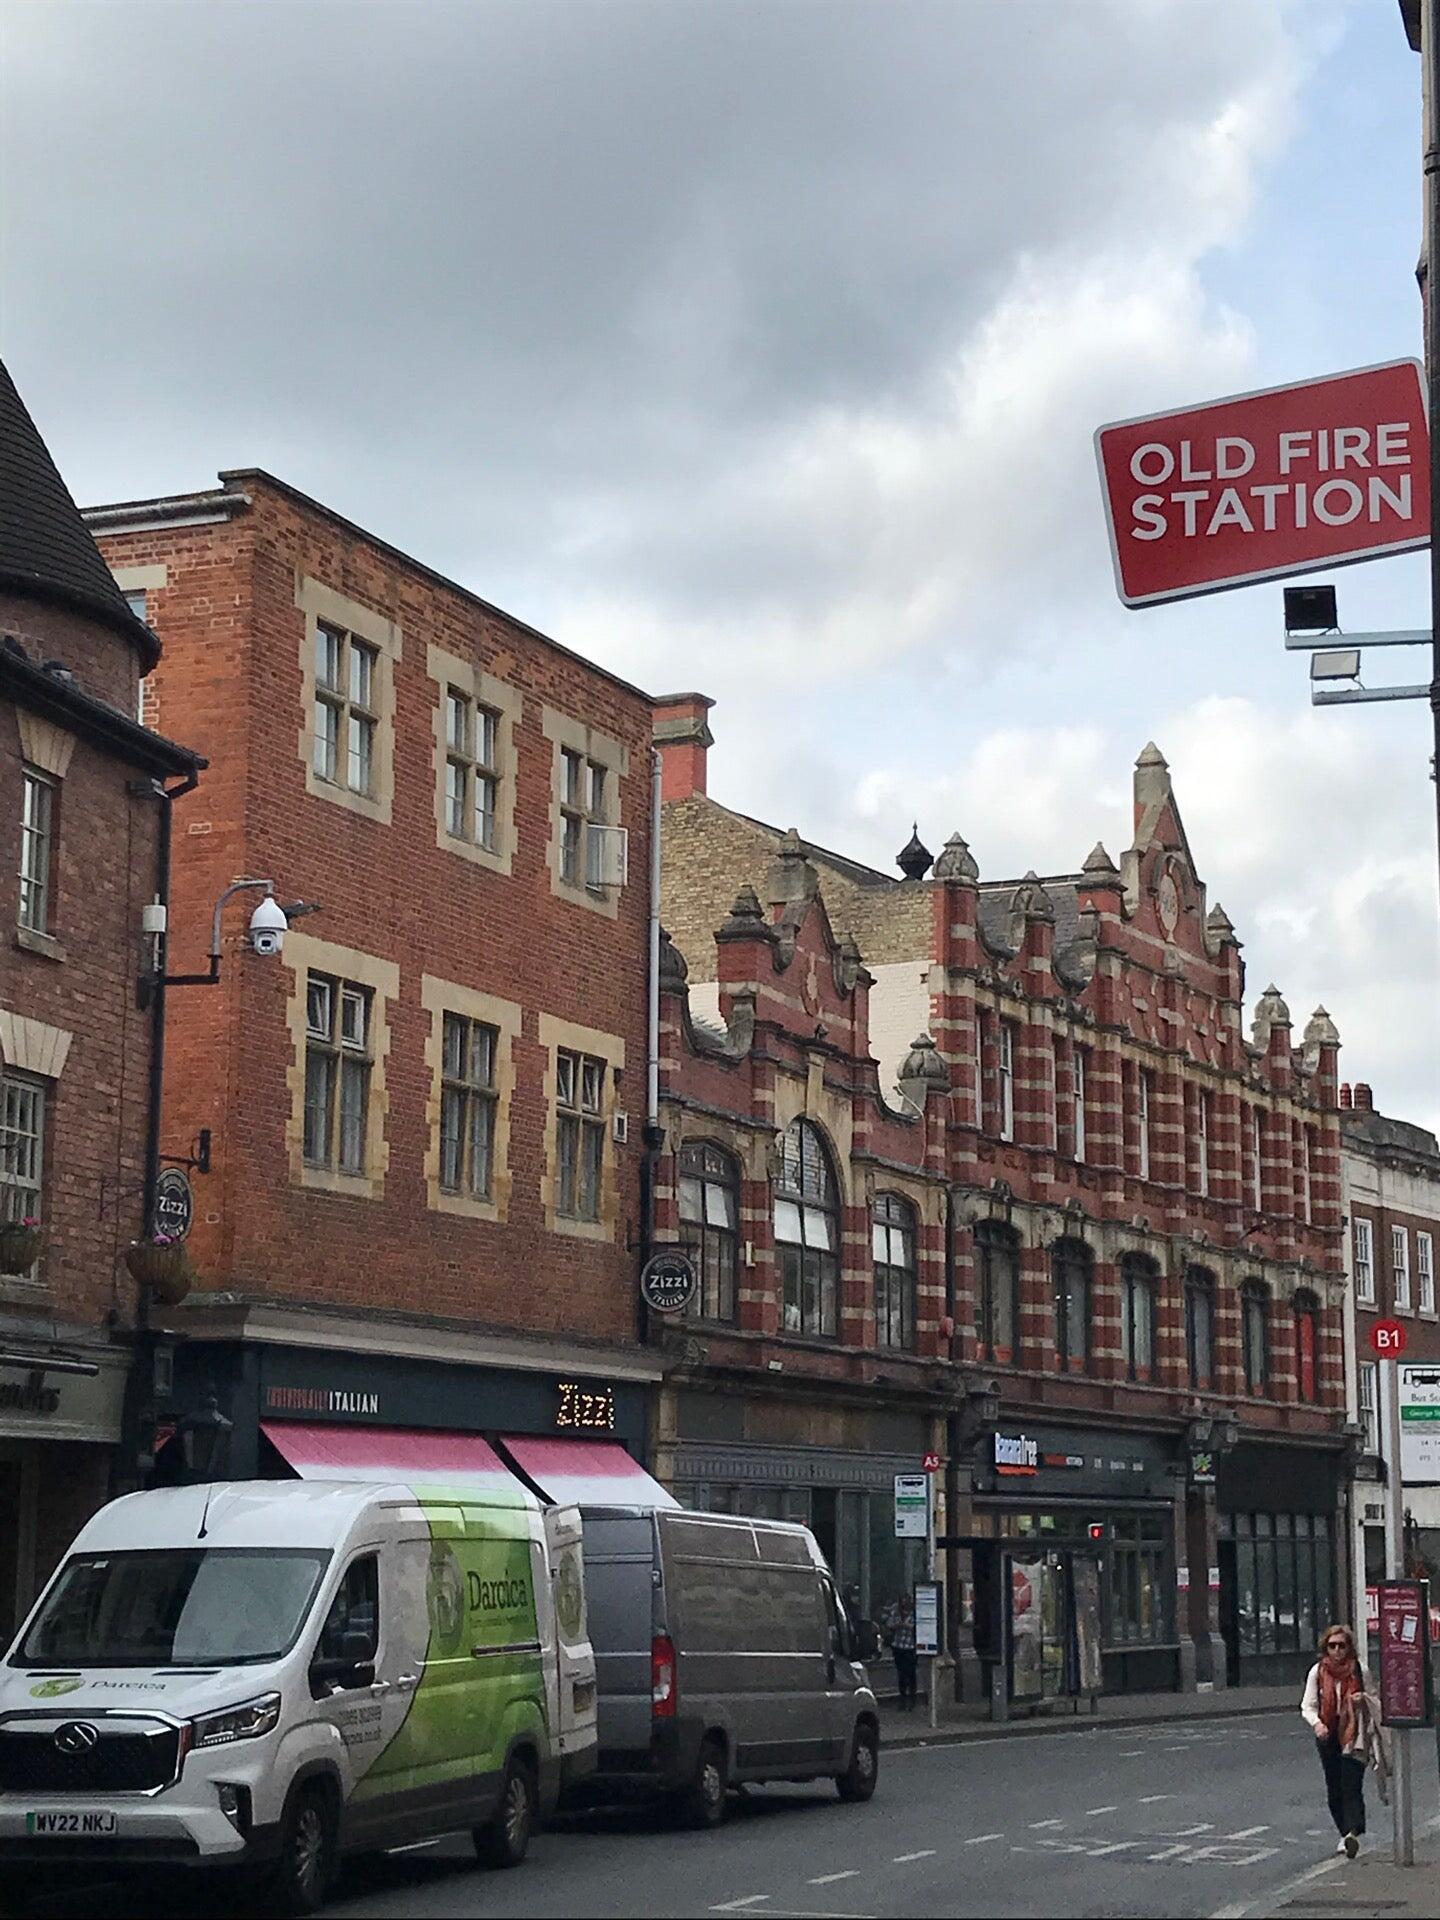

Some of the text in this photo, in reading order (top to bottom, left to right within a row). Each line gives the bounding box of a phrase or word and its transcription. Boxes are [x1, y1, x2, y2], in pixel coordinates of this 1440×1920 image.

[1130, 422, 1411, 486] OLD FIRE
[1131, 474, 1413, 541] STATION
[159, 1195, 188, 1217] Zizzi
[649, 1273, 688, 1289] Zizzi
[1377, 1329, 1400, 1348] B1
[329, 1390, 379, 1413] ITALIAN
[556, 1383, 615, 1429] Zizzi
[924, 1456, 939, 1468] A5
[467, 1569, 528, 1611] Darcica
[83, 1814, 115, 1832] NKJ
